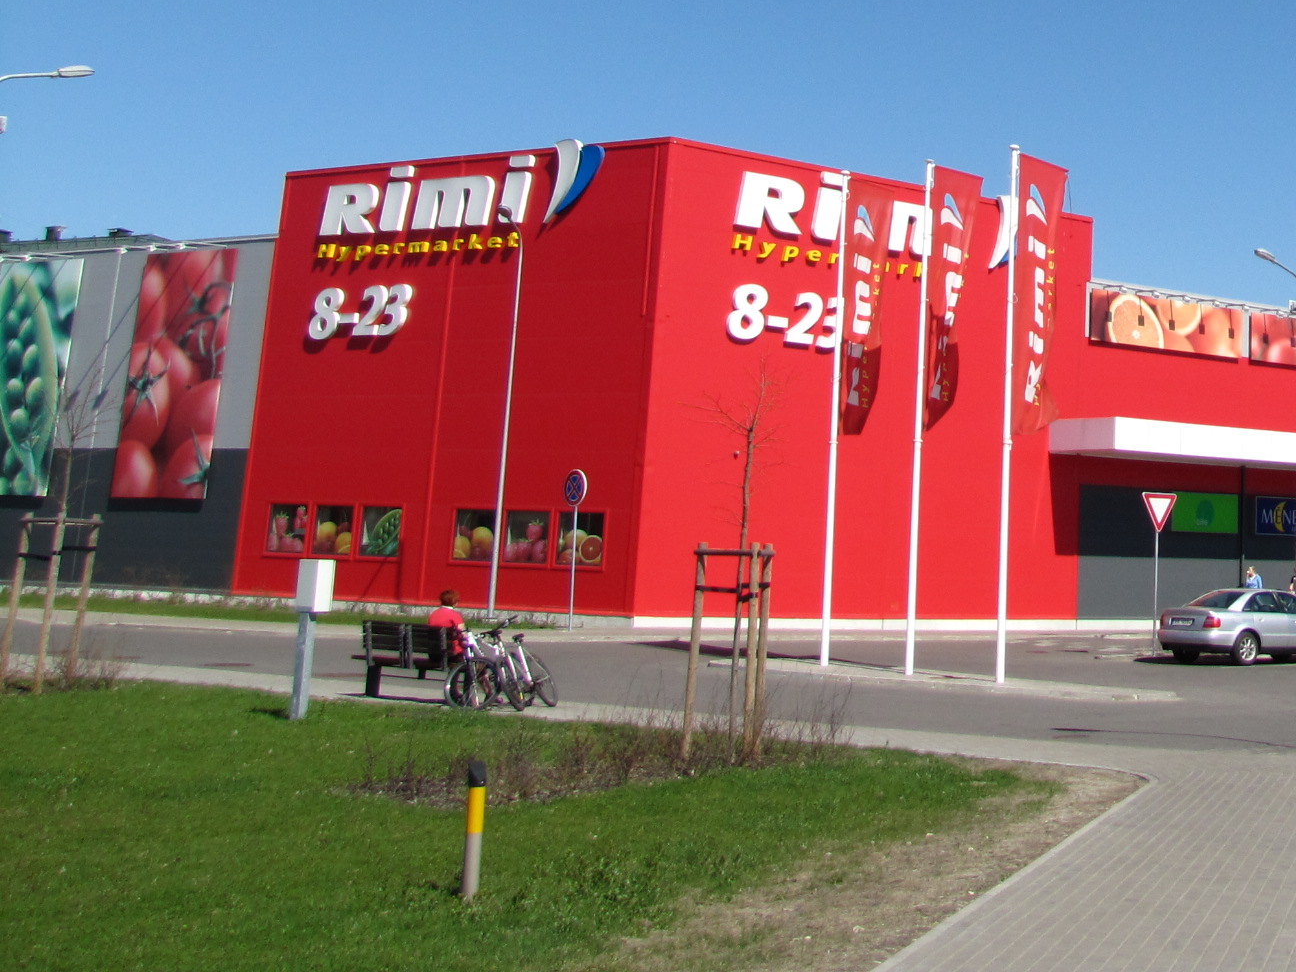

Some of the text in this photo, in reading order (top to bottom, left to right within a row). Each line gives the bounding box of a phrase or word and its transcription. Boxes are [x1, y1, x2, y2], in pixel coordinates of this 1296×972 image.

[318, 155, 537, 236] Rimi
[317, 232, 520, 262] Hypermarket
[308, 283, 414, 341] 8-23
[726, 283, 845, 349] 8-23
[1024, 235, 1047, 404] Rimi
